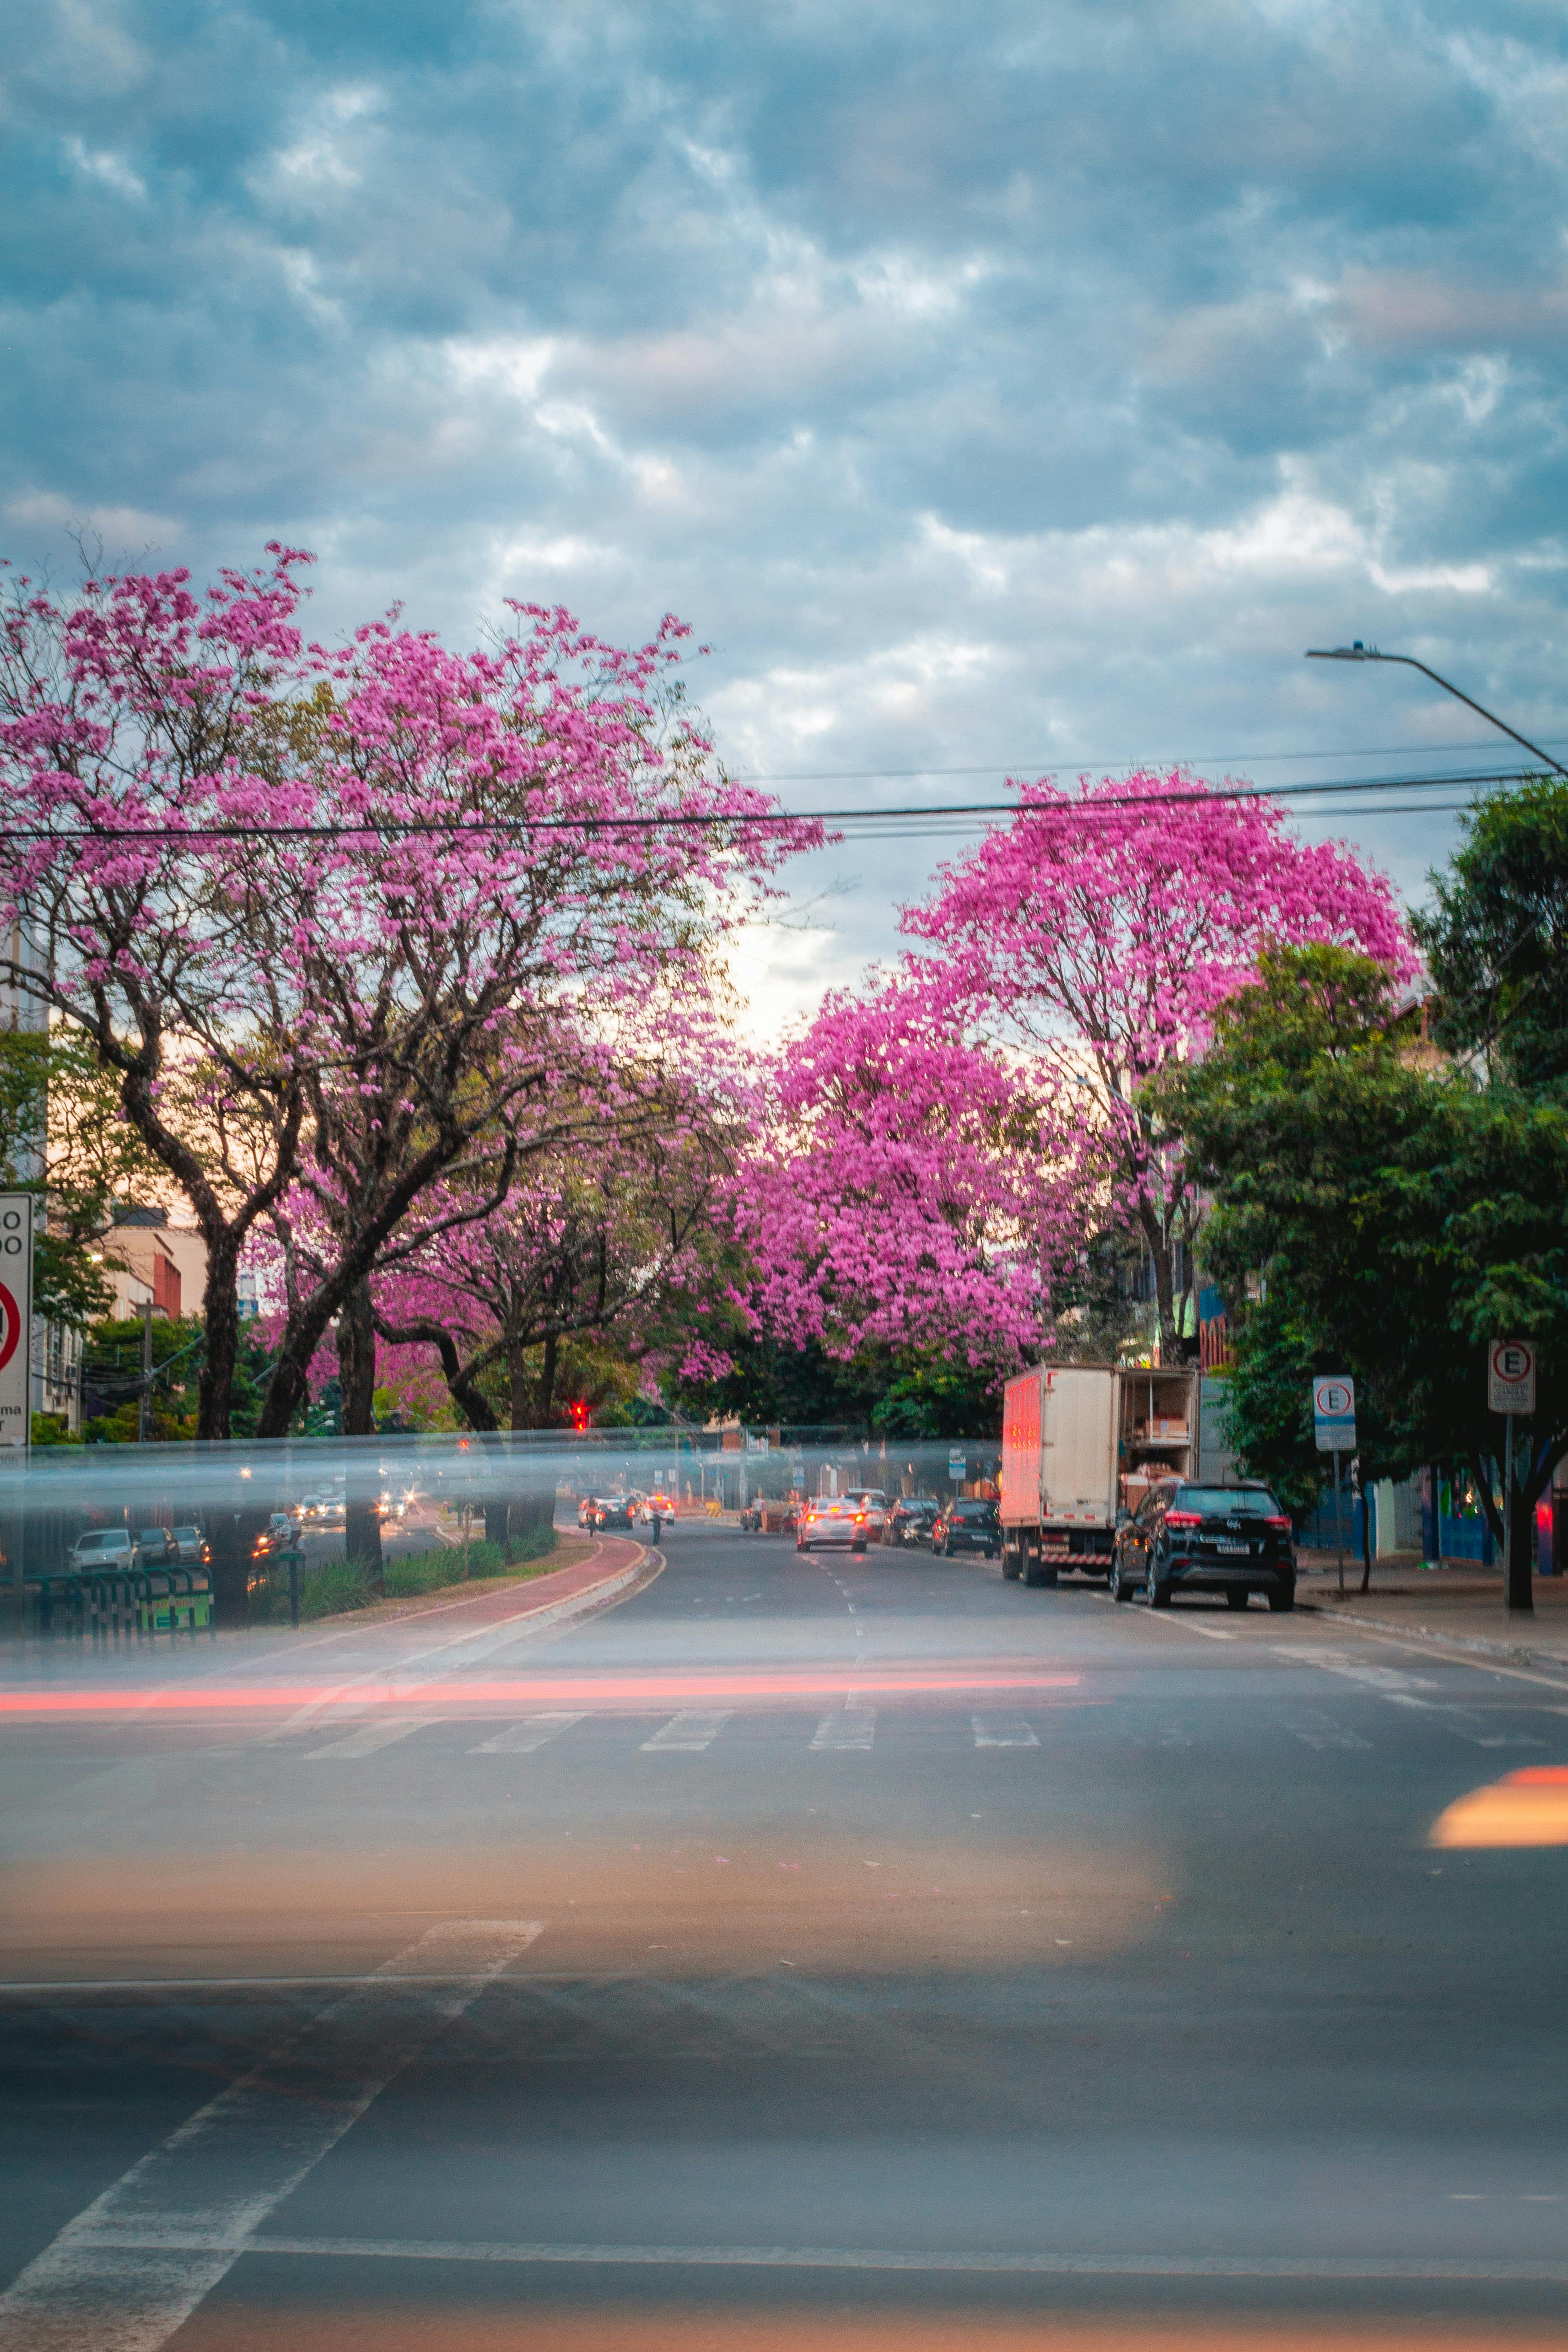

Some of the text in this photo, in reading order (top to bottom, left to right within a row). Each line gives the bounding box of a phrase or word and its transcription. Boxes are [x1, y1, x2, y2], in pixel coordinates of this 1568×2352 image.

[0, 1211, 21, 1229] O
[0, 1235, 22, 1254] O
[1505, 1352, 1520, 1373] E
[1328, 1389, 1339, 1409] E
[1, 1406, 21, 1414] ma
